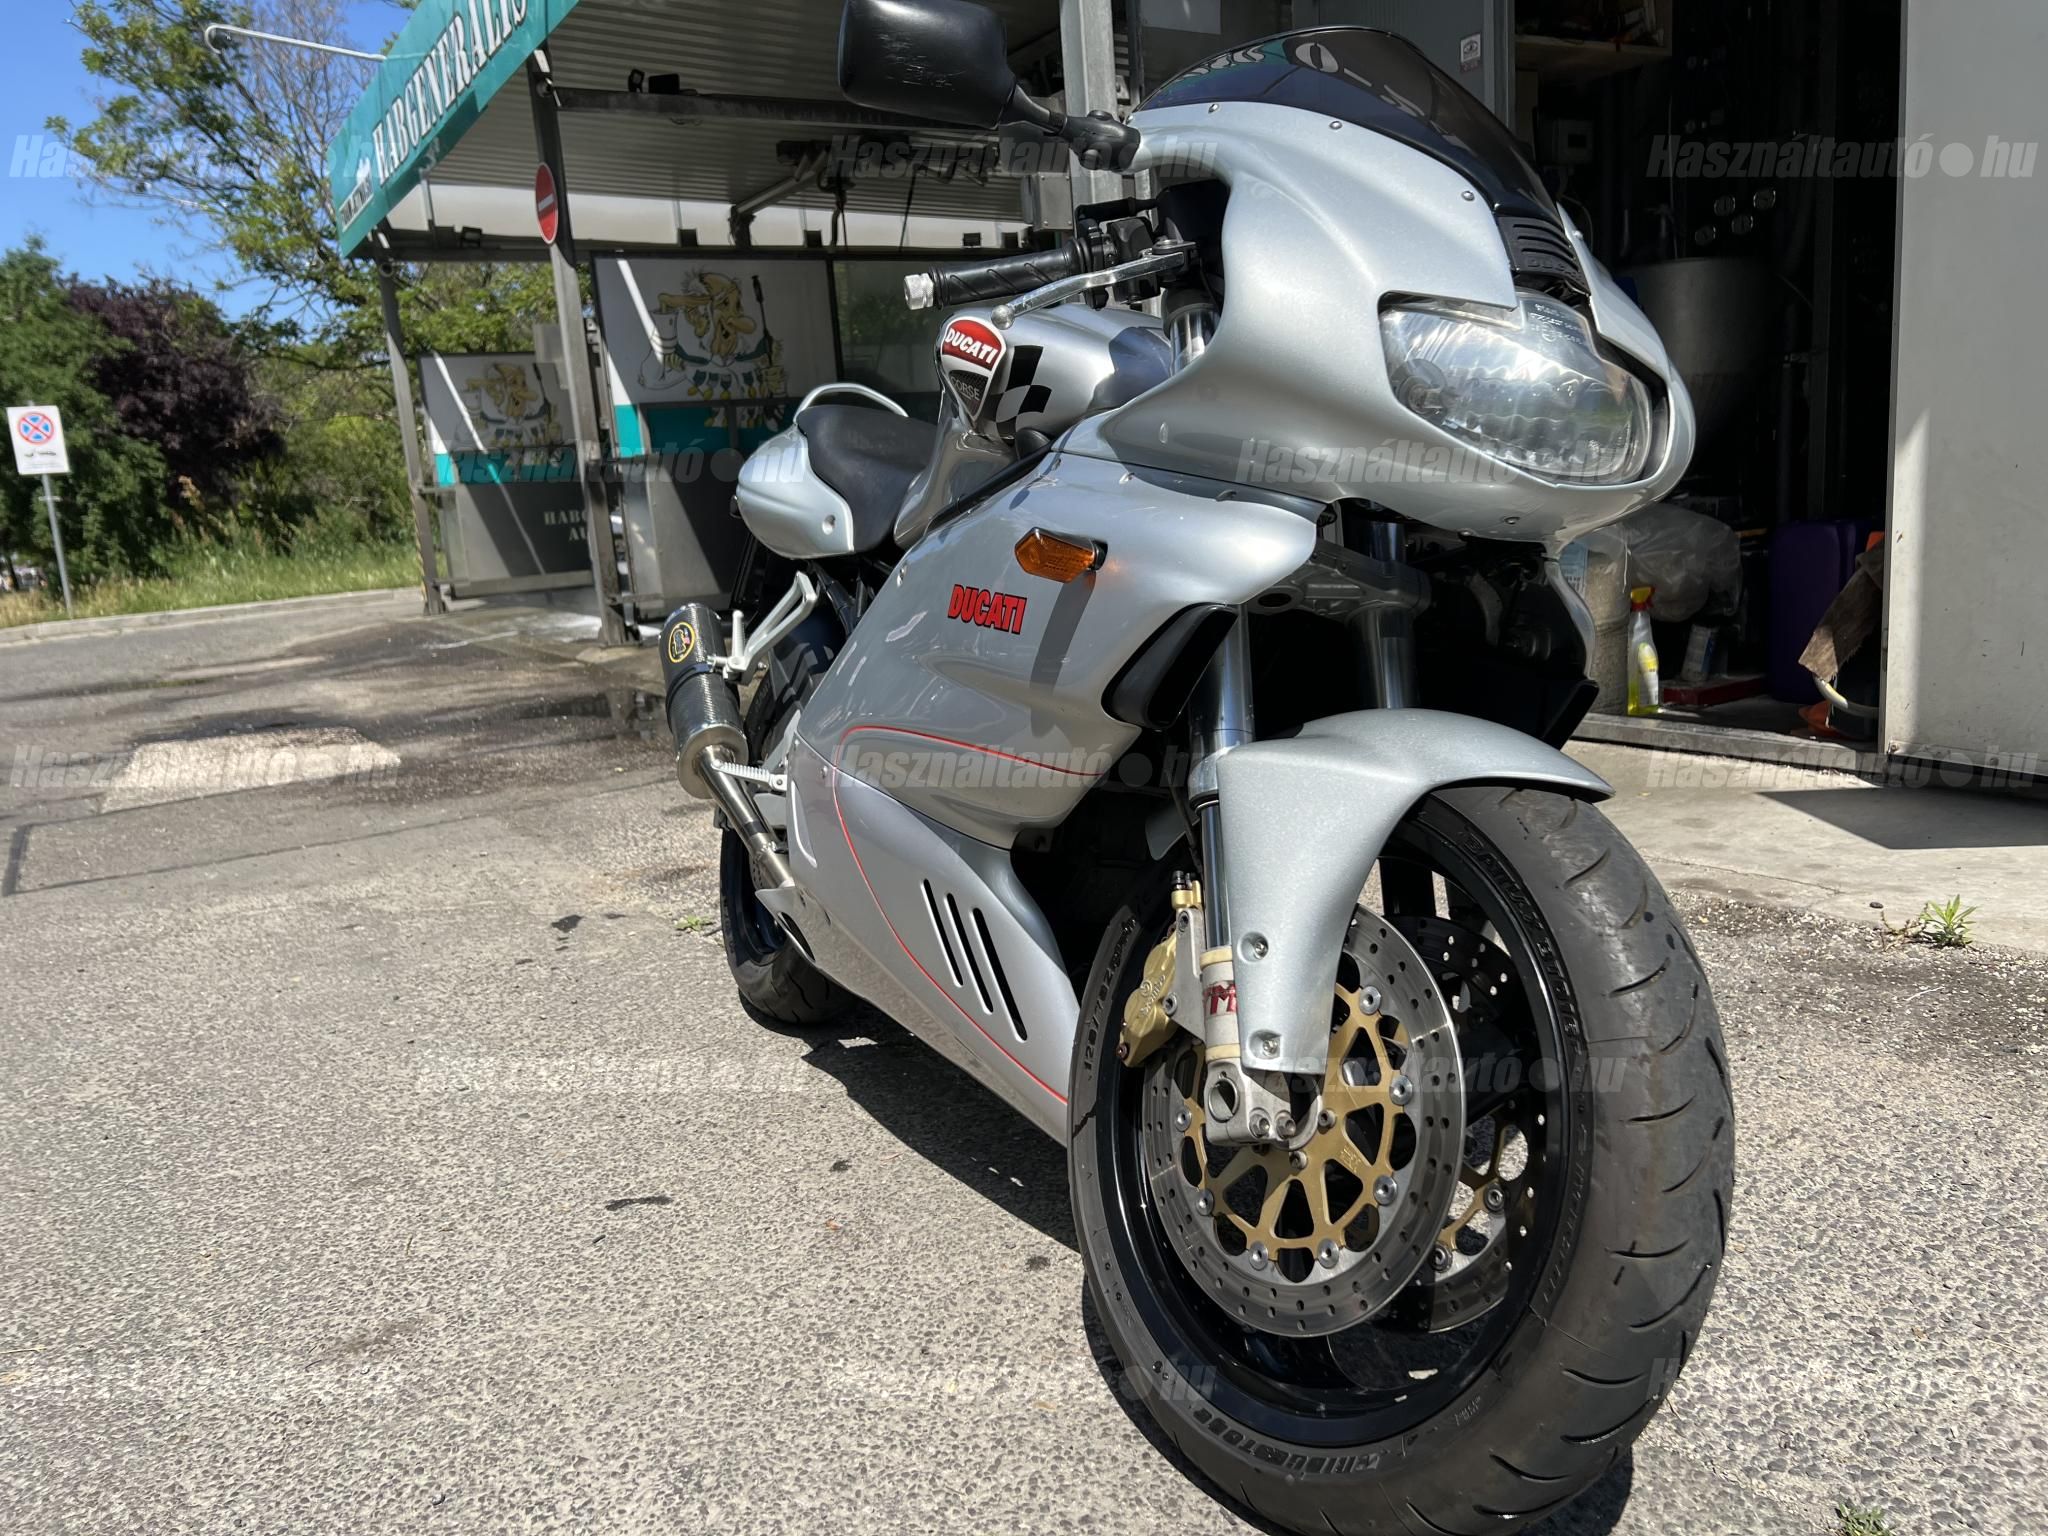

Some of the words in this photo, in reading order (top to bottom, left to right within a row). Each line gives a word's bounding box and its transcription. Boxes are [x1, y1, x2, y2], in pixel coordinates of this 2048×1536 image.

[944, 327, 999, 364] DUCATI
[949, 375, 981, 401] CORSE
[947, 583, 1028, 635] DUCATI
